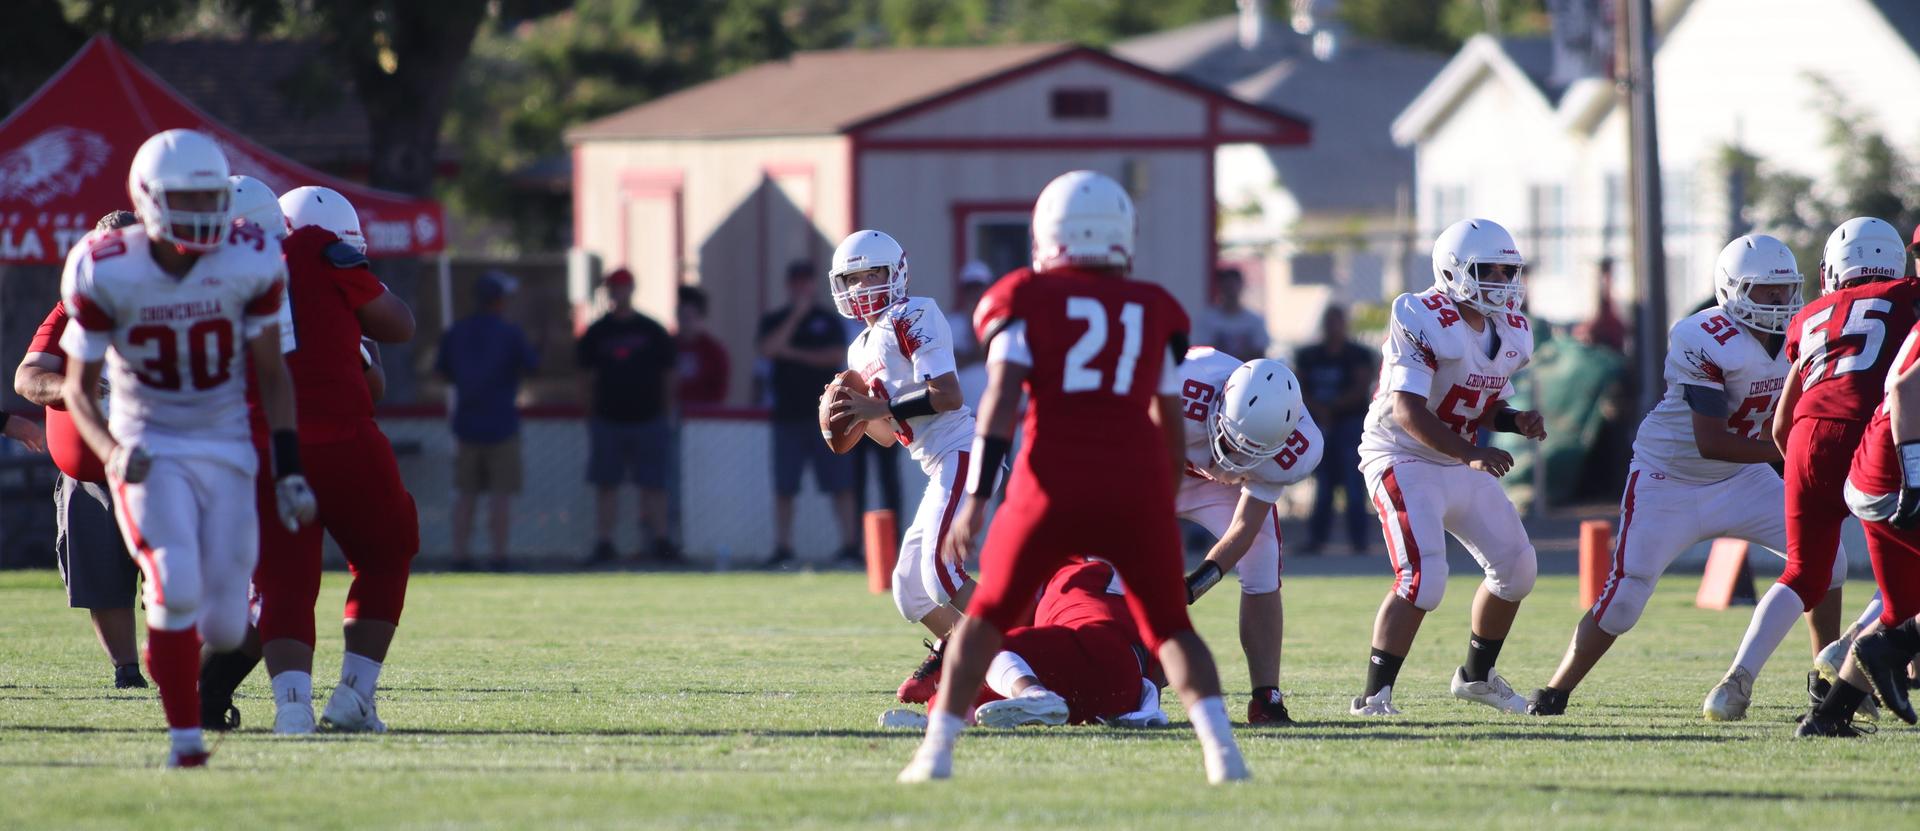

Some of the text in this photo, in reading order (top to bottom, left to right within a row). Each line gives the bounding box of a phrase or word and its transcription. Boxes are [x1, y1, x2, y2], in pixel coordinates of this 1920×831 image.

[1860, 266, 1895, 277] Riddell
[1421, 293, 1460, 329] 54
[1700, 314, 1740, 346] 51
[127, 317, 233, 393] 30
[1062, 296, 1144, 395] 21
[1799, 298, 1894, 392] 55
[1183, 378, 1215, 422] 69
[1749, 375, 1788, 395] CHOWCHIL
